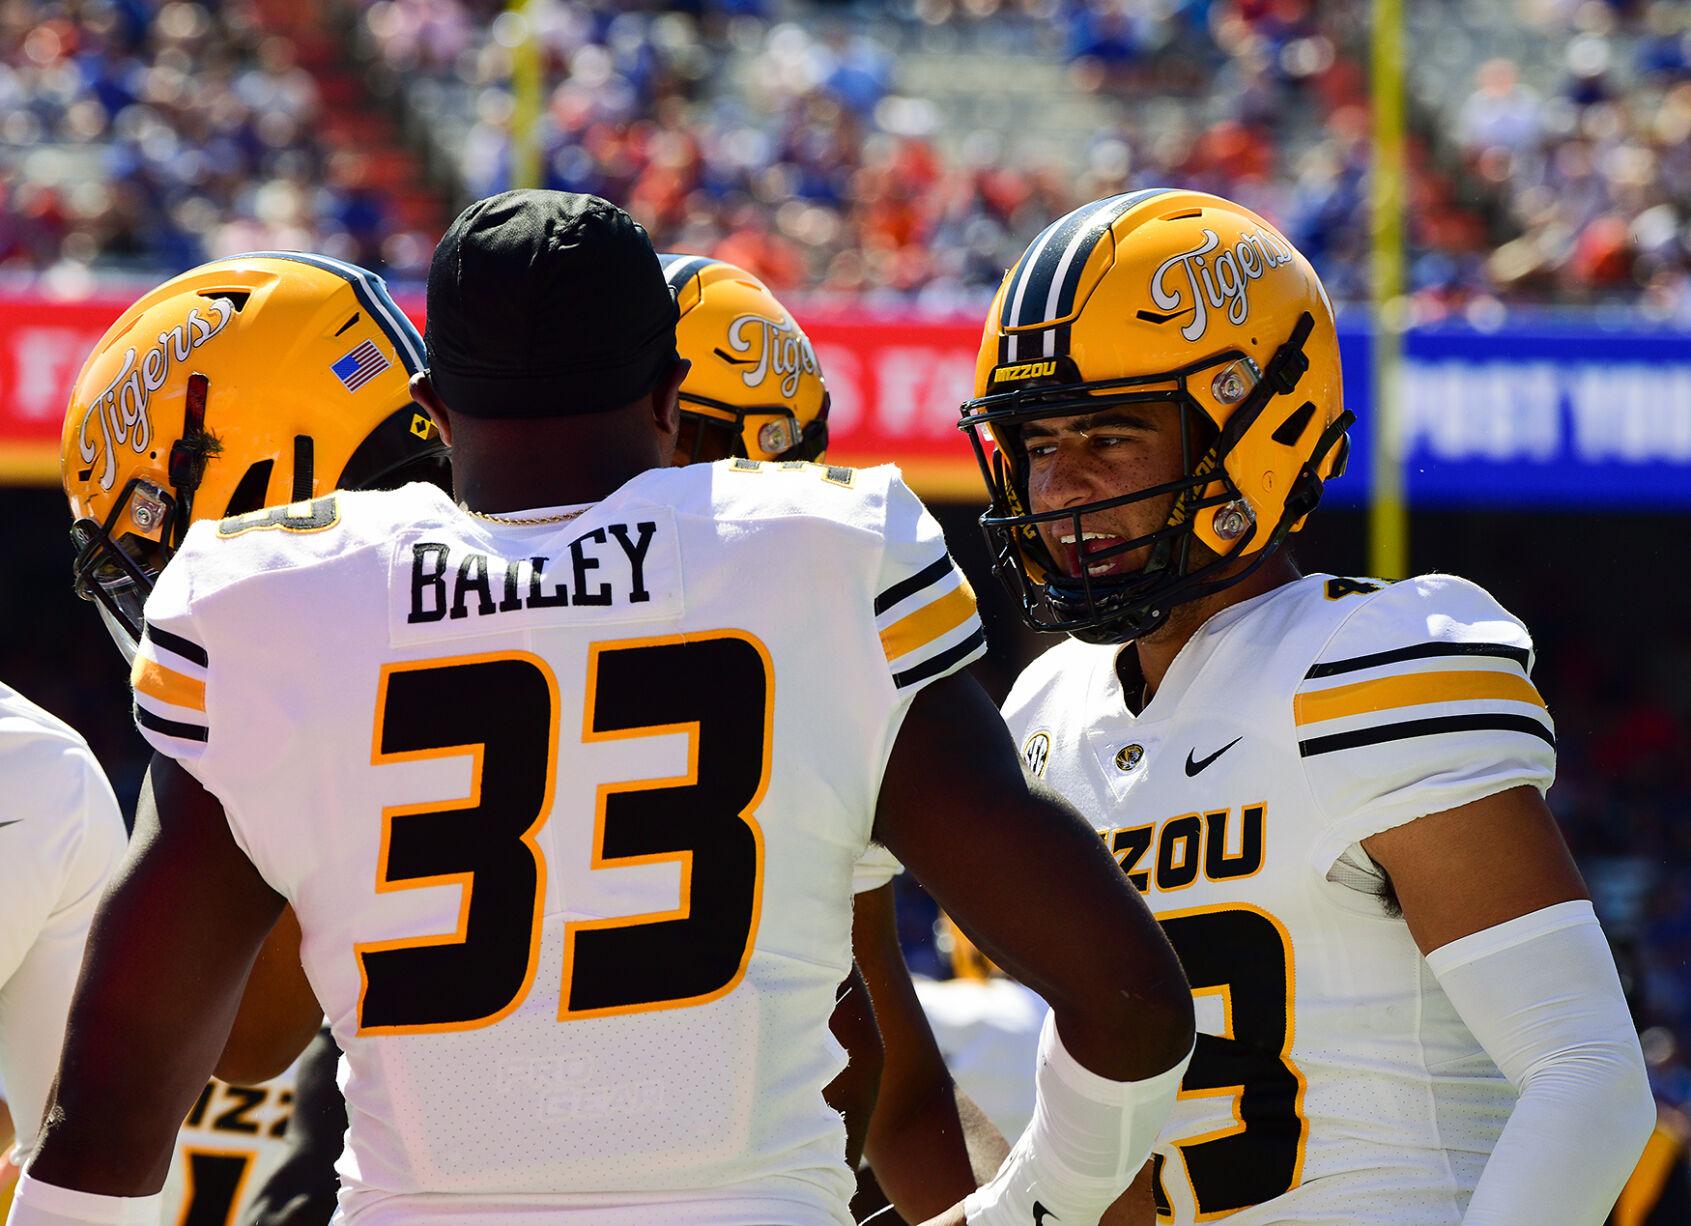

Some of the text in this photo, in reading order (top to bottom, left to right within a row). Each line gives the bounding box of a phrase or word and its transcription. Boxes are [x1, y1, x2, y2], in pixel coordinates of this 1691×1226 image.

[1150, 228, 1293, 342] Tigers
[79, 297, 235, 491] Tigers
[727, 314, 822, 398] Tige
[407, 521, 657, 625] BAILEY
[353, 627, 776, 1038] 33
[1096, 801, 1268, 896] ZOU
